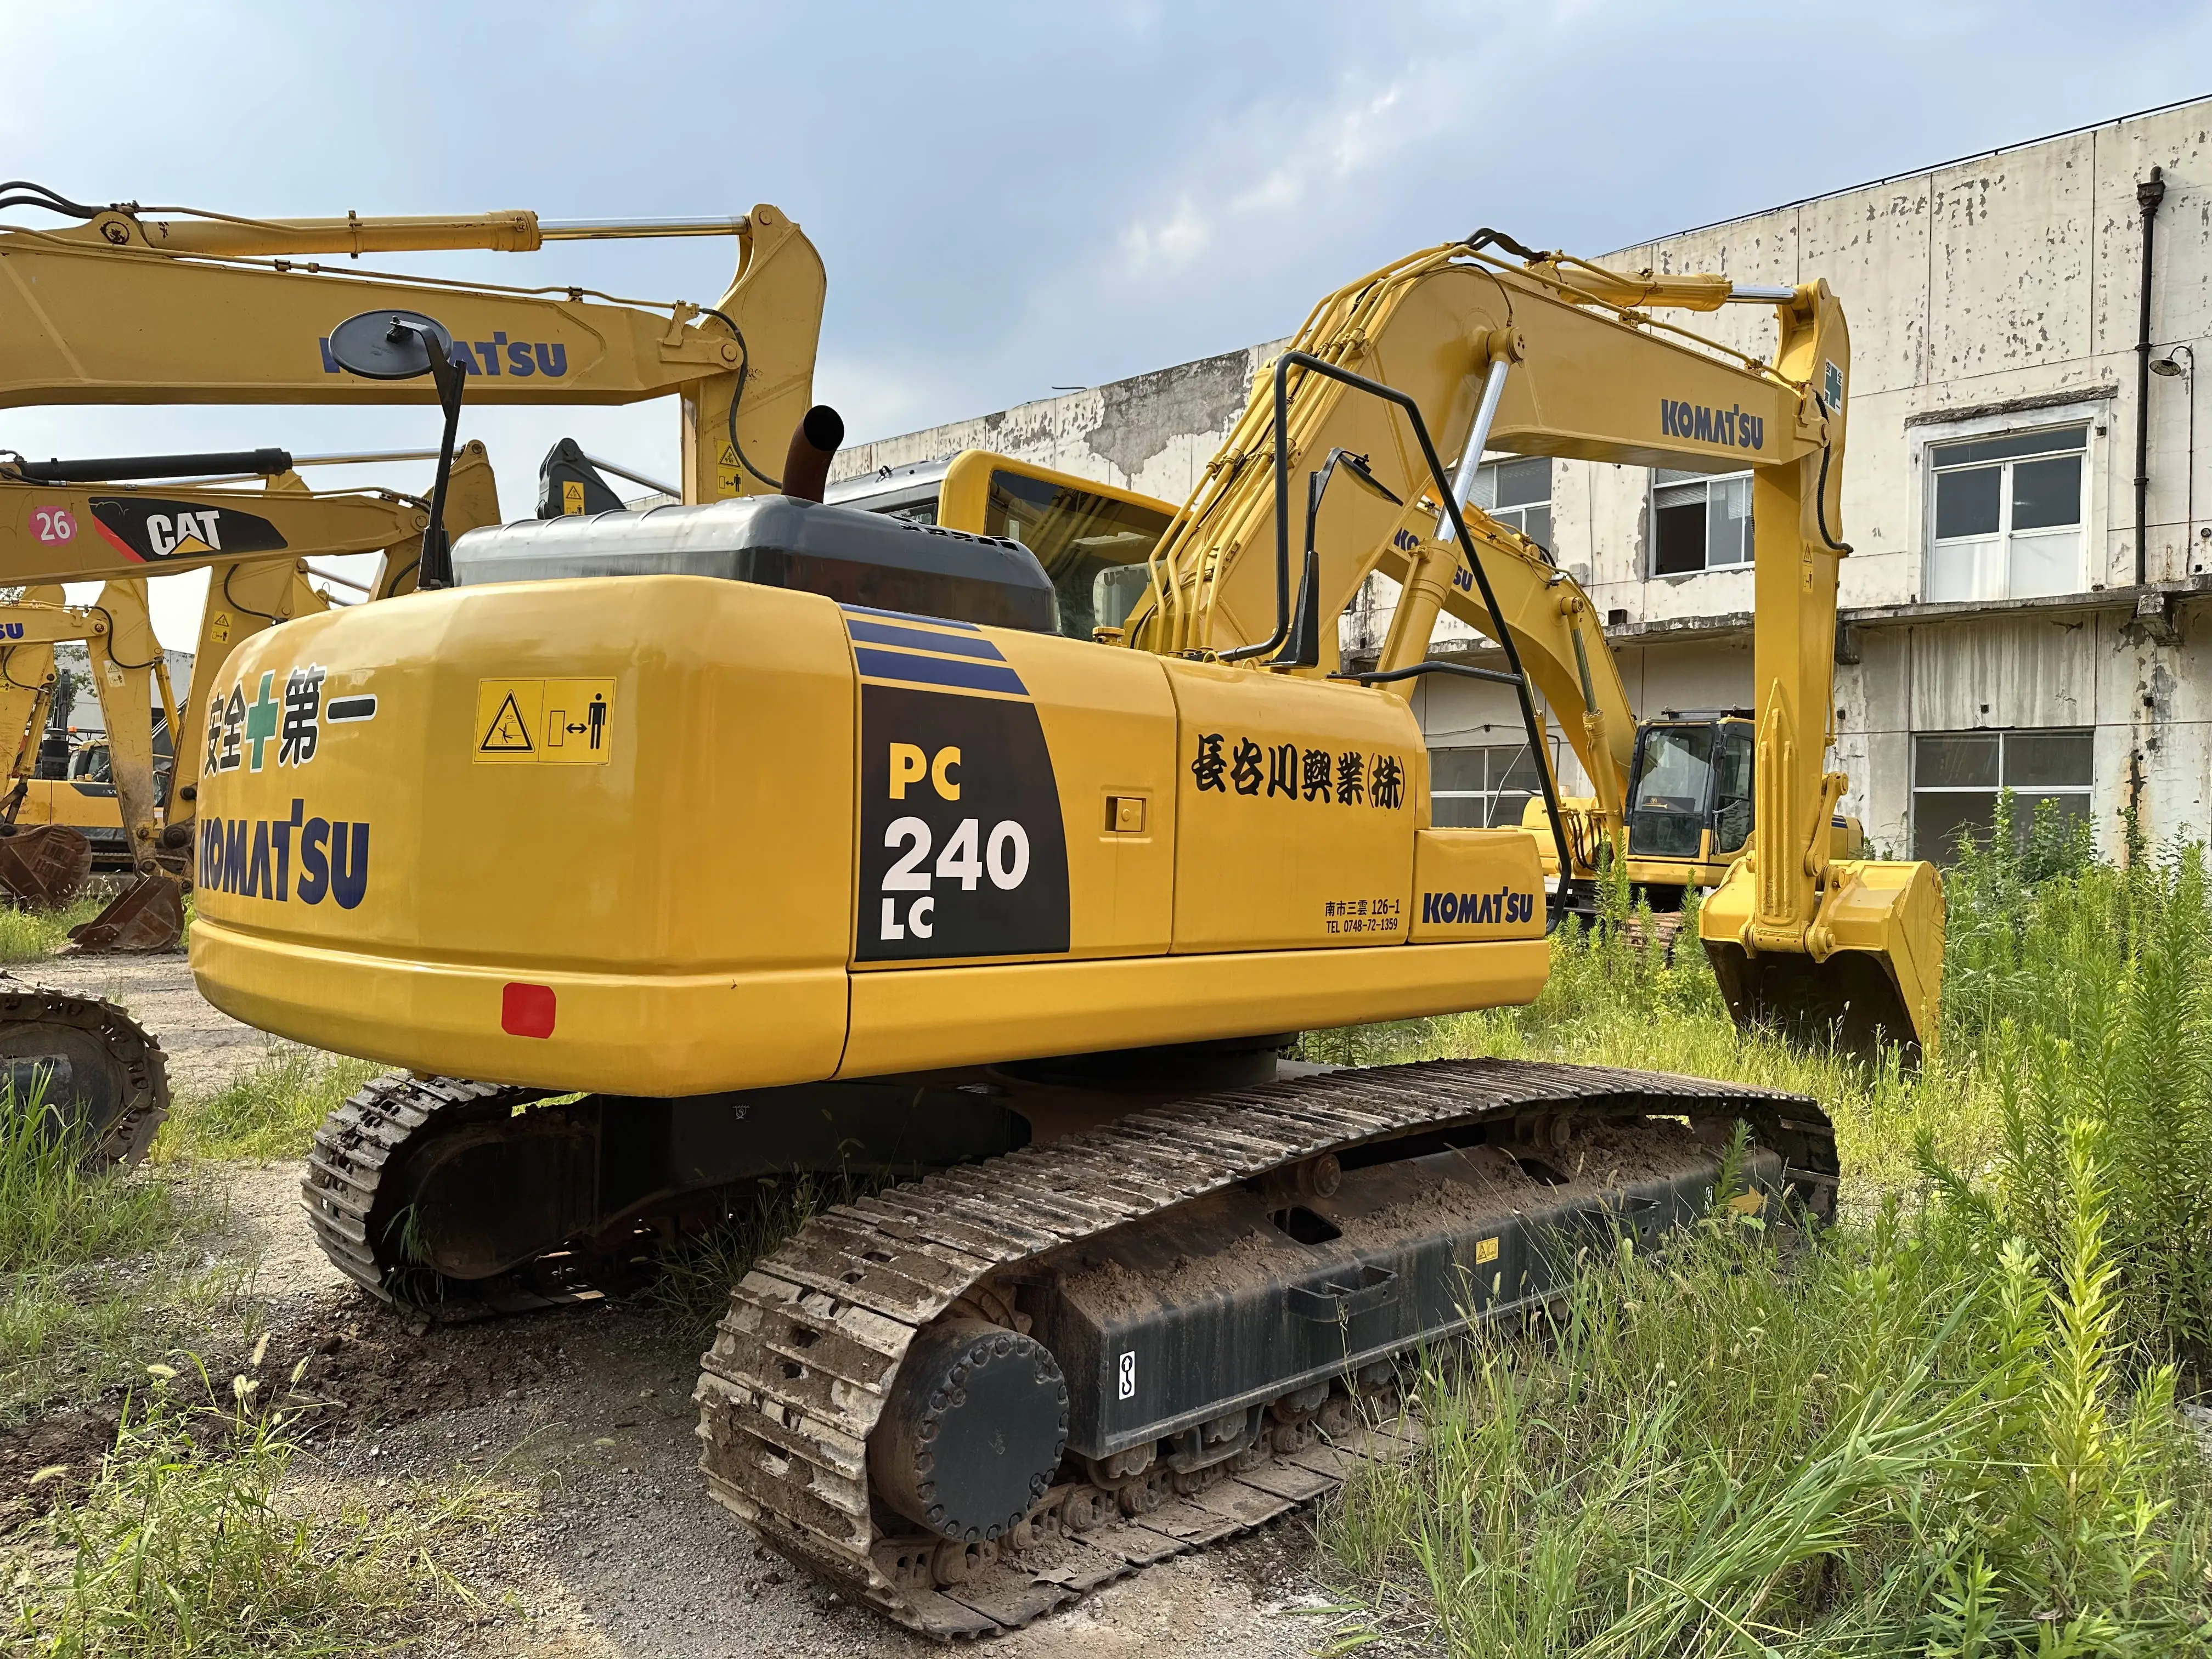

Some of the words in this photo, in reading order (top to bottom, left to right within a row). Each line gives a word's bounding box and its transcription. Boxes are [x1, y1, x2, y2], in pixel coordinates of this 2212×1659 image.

[1661, 399, 1763, 450] KOMATSU
[36, 511, 70, 540] 26
[146, 510, 221, 555] CAT
[889, 742, 961, 801] PC
[199, 798, 369, 910] KOMATSU
[882, 816, 1030, 891] 240
[881, 896, 934, 940] LC
[1325, 900, 1368, 917] 南市三雲
[1372, 899, 1400, 915] 126-1
[1326, 920, 1340, 933] TEL
[1344, 918, 1398, 932] 0748-72-1359
[1422, 886, 1533, 923] KOMATSU
